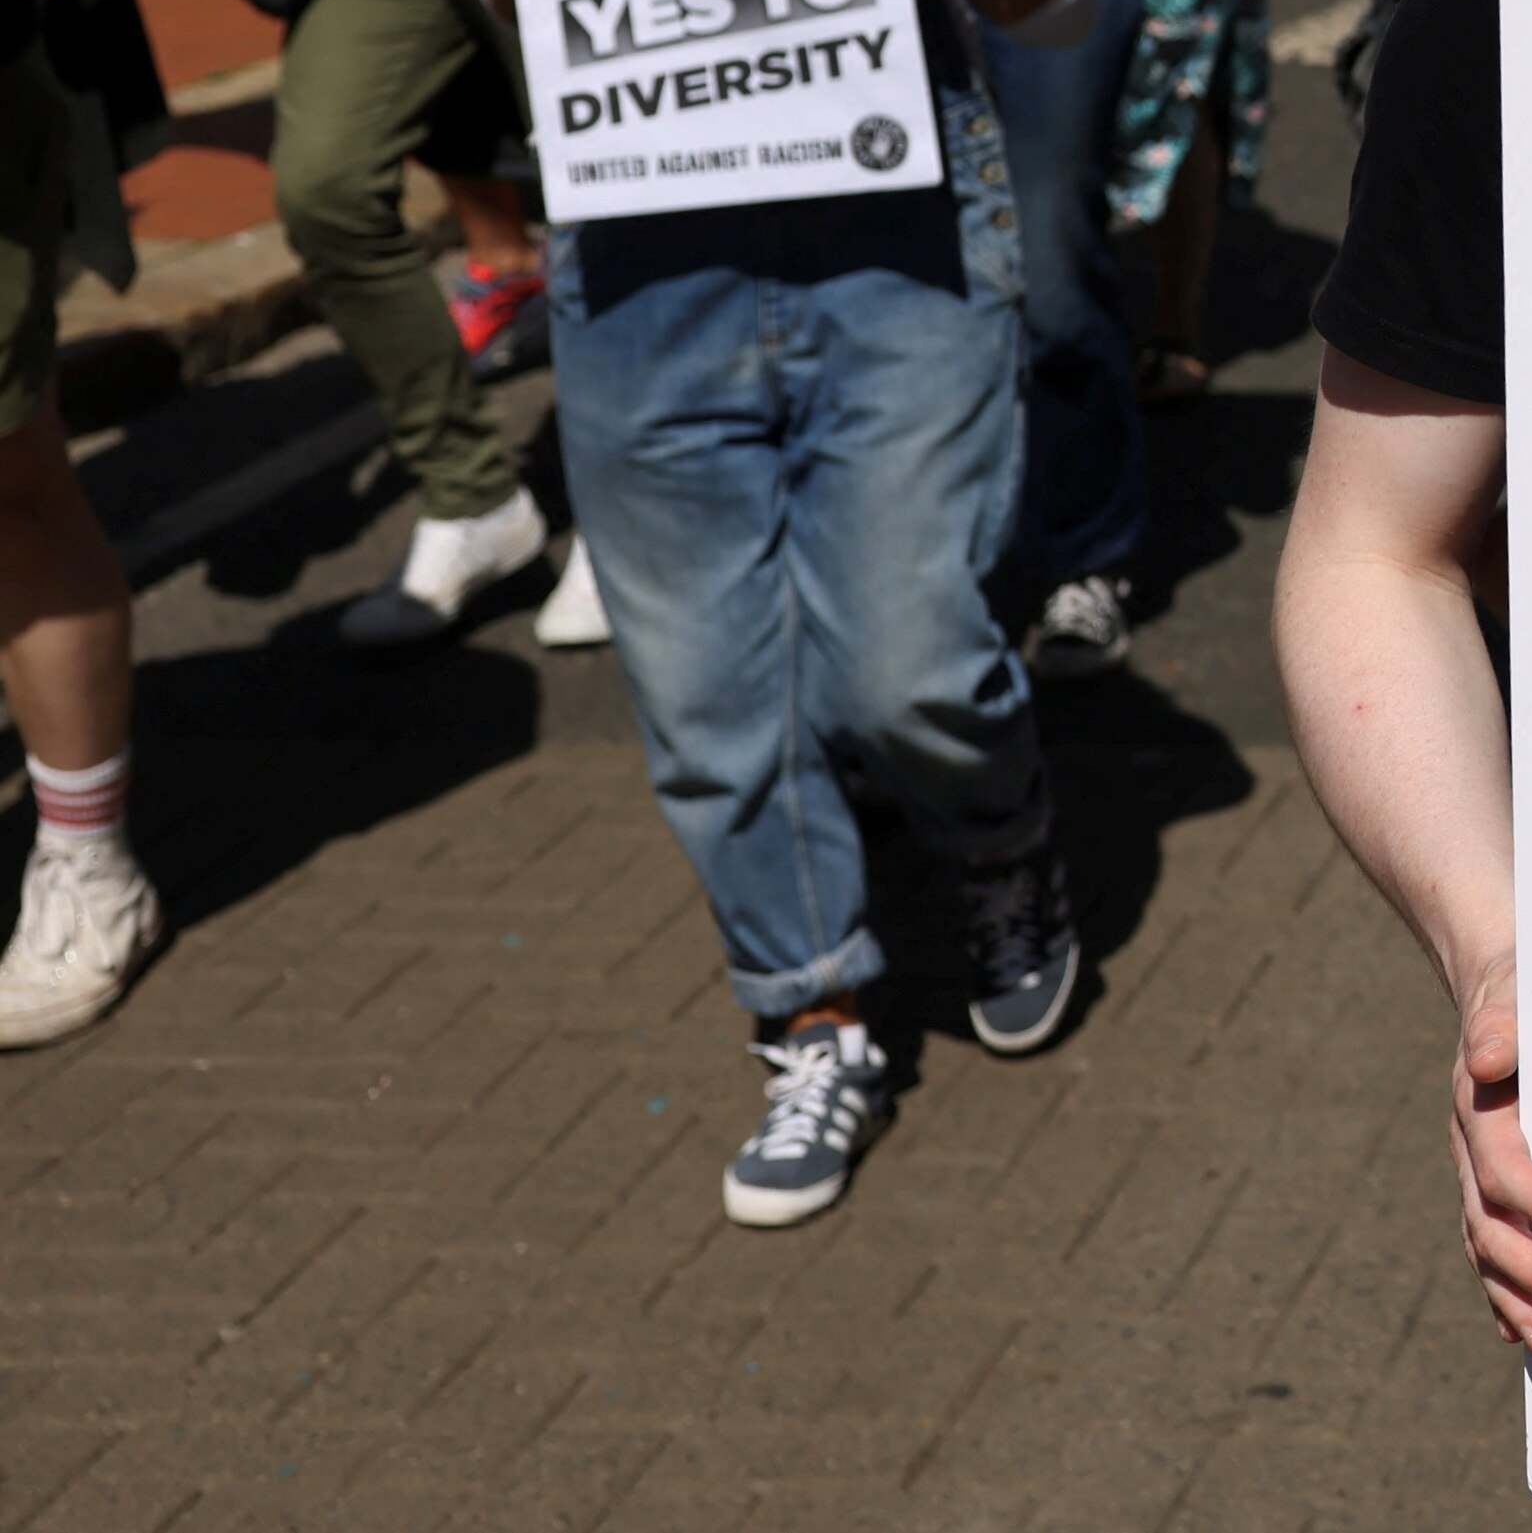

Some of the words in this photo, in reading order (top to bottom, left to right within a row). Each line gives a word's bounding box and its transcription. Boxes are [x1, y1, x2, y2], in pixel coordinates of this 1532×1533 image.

[560, 26, 892, 136] DIVERSITY
[568, 154, 647, 185] UNITED
[656, 145, 750, 177] AGAINST
[757, 137, 843, 166] RACISM
